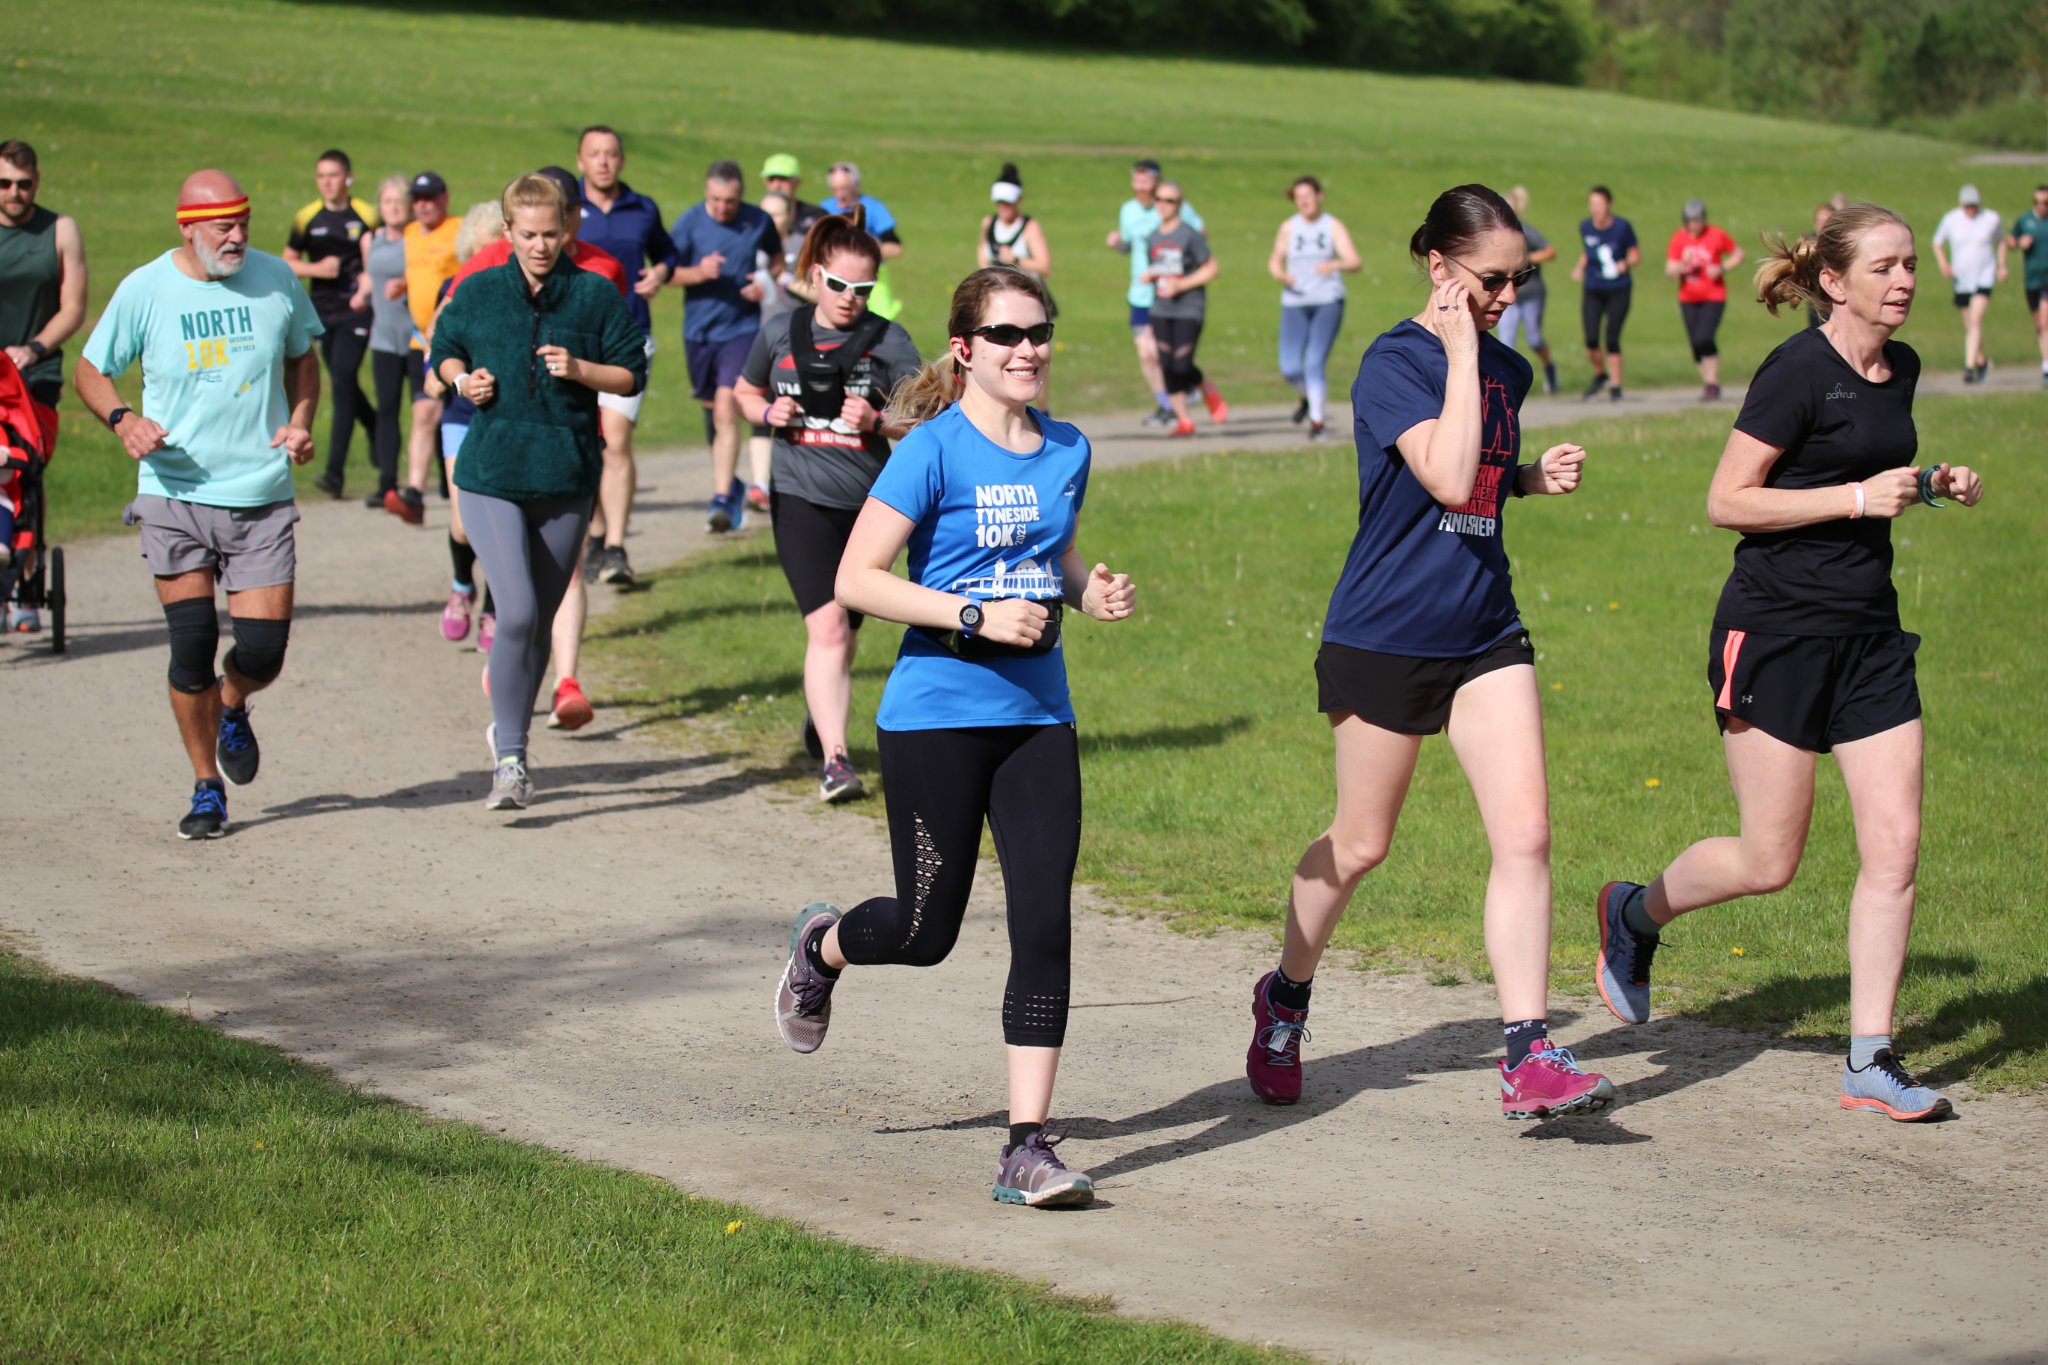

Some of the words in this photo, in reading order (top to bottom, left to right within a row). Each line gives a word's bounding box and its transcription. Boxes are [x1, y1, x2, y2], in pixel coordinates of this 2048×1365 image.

[180, 306, 253, 341] NORTH
[183, 337, 230, 370] 10K
[975, 484, 1038, 508] NORTH
[975, 506, 1040, 525] TYNESIDE
[975, 523, 1016, 549] 10K
[1014, 523, 1027, 546] 2022
